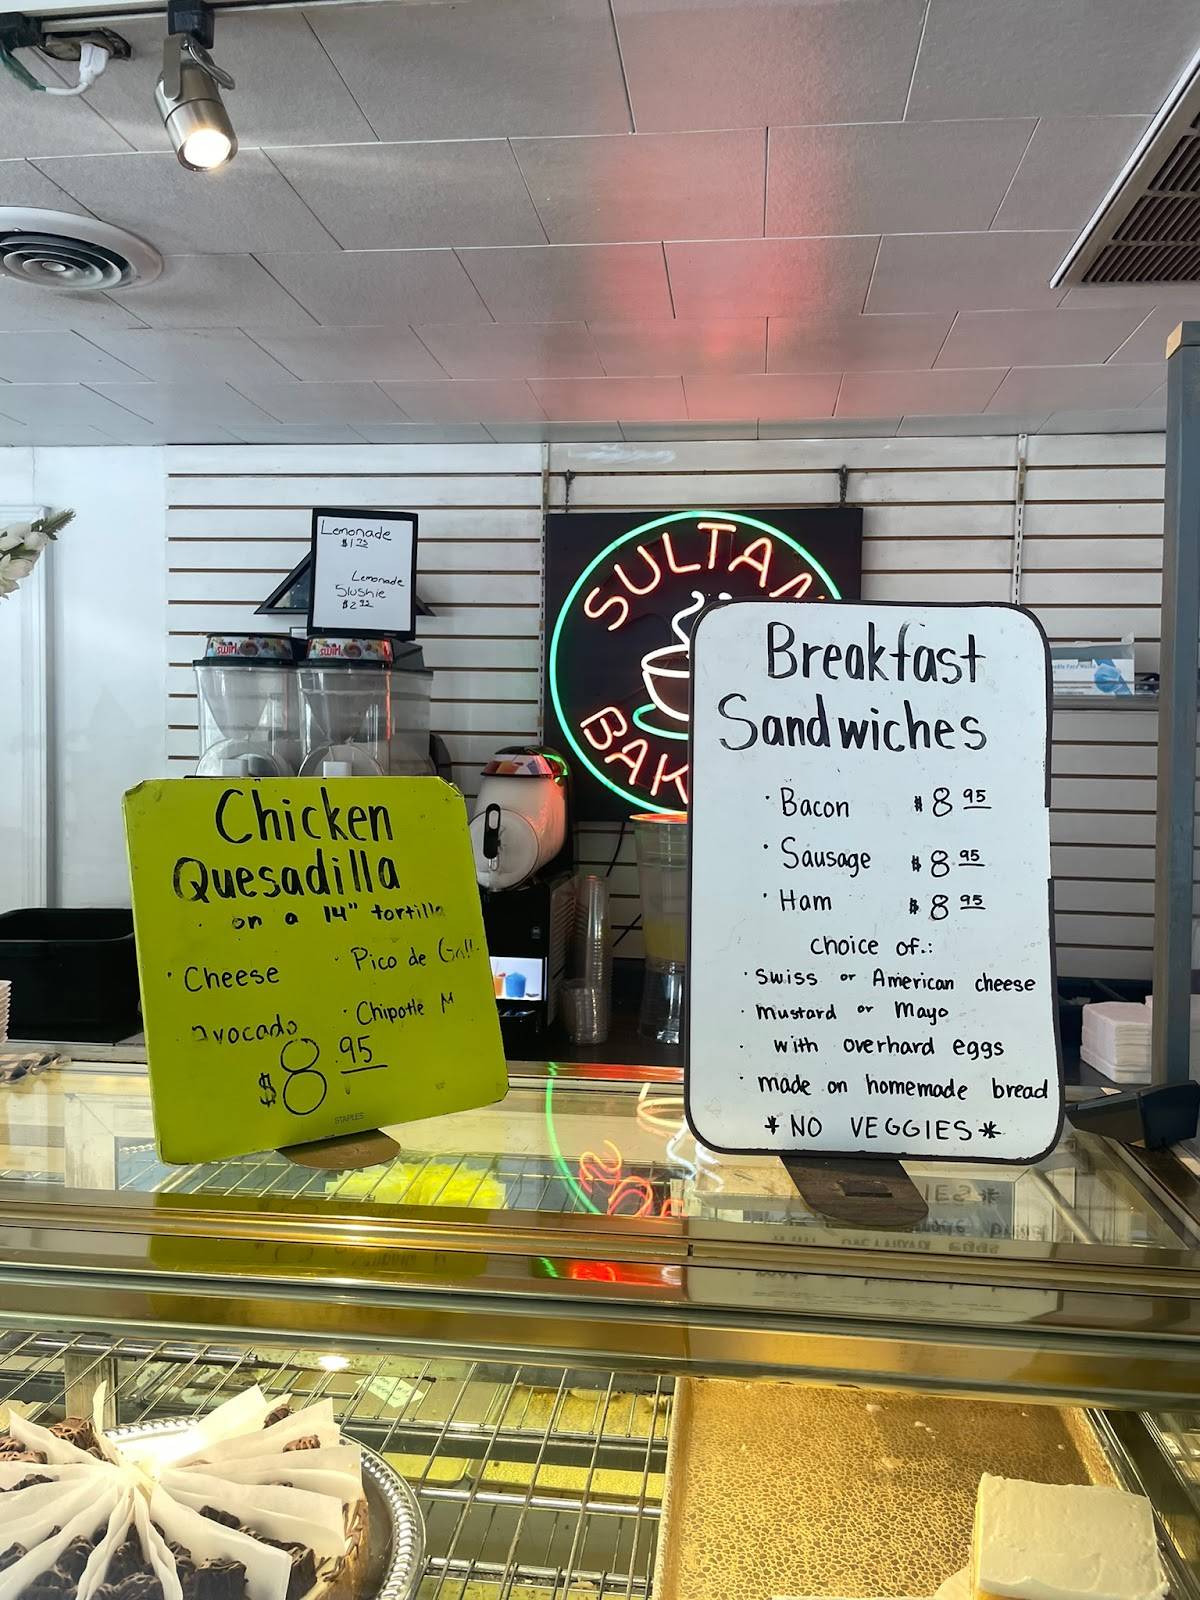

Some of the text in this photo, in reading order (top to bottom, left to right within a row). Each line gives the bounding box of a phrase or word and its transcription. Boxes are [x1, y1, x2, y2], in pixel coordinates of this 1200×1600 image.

[320, 519, 393, 541] Lemonade
[351, 570, 405, 587] Lemonade
[767, 621, 987, 685] Breakfast
[717, 692, 987, 753] Sandwiches
[580, 706, 688, 804] BAK
[215, 786, 394, 844] Chicken
[780, 786, 850, 819] Bacon
[780, 836, 872, 879] Sausage
[173, 848, 401, 903] Quesadilla
[779, 888, 832, 912] Ham
[231, 915, 263, 930] on
[284, 912, 299, 926] a
[350, 946, 398, 971] Pico
[408, 946, 427, 967] de
[810, 935, 879, 956] choice
[184, 966, 280, 993] Cheese
[839, 973, 857, 982] or
[872, 967, 954, 991] American
[974, 972, 1036, 993] cheese
[356, 998, 425, 1026] Chipotle
[856, 1004, 875, 1014] or
[773, 1035, 1005, 1061] with overhard eggs
[757, 1073, 1048, 1101] made on homemade bread
[334, 1112, 364, 1125] STAPLES
